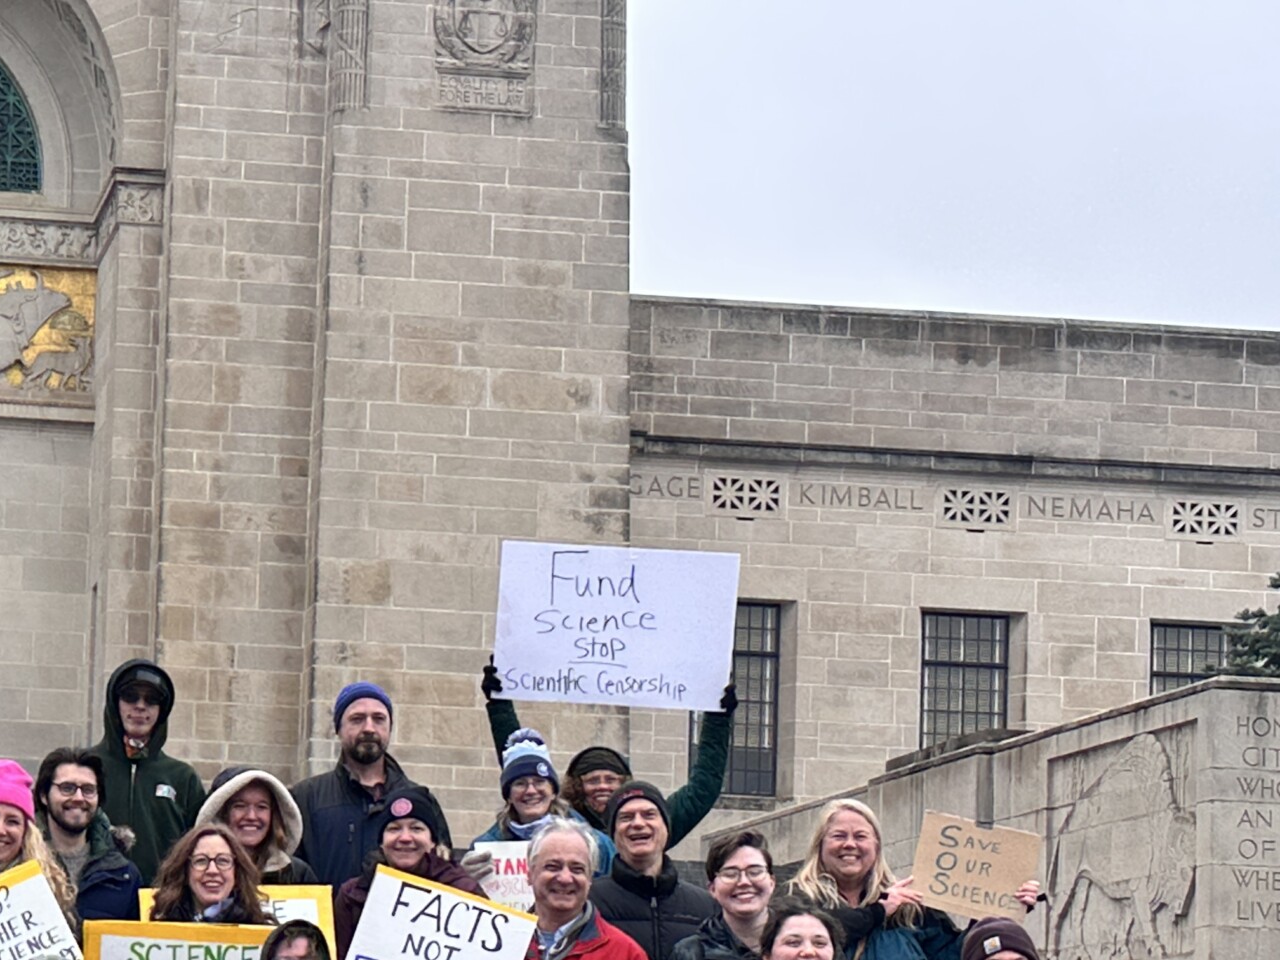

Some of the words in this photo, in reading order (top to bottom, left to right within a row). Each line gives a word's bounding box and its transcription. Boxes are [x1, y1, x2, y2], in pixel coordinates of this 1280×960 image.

[439, 89, 471, 103] FORE
[473, 91, 495, 105] THE
[629, 474, 701, 499] GAGE
[799, 483, 924, 511] KIMBALL
[1027, 495, 1156, 523] NEMAHA
[550, 550, 640, 605] Fund
[504, 667, 588, 695] Scientific
[597, 669, 687, 701] Censorship
[1236, 808, 1273, 829] AN
[938, 824, 1002, 855] SAVE
[1238, 838, 1276, 860] OF
[492, 858, 529, 876] TAN
[935, 851, 993, 878] OUR
[928, 872, 1021, 911] SCIENCE
[391, 881, 510, 953] FACTS
